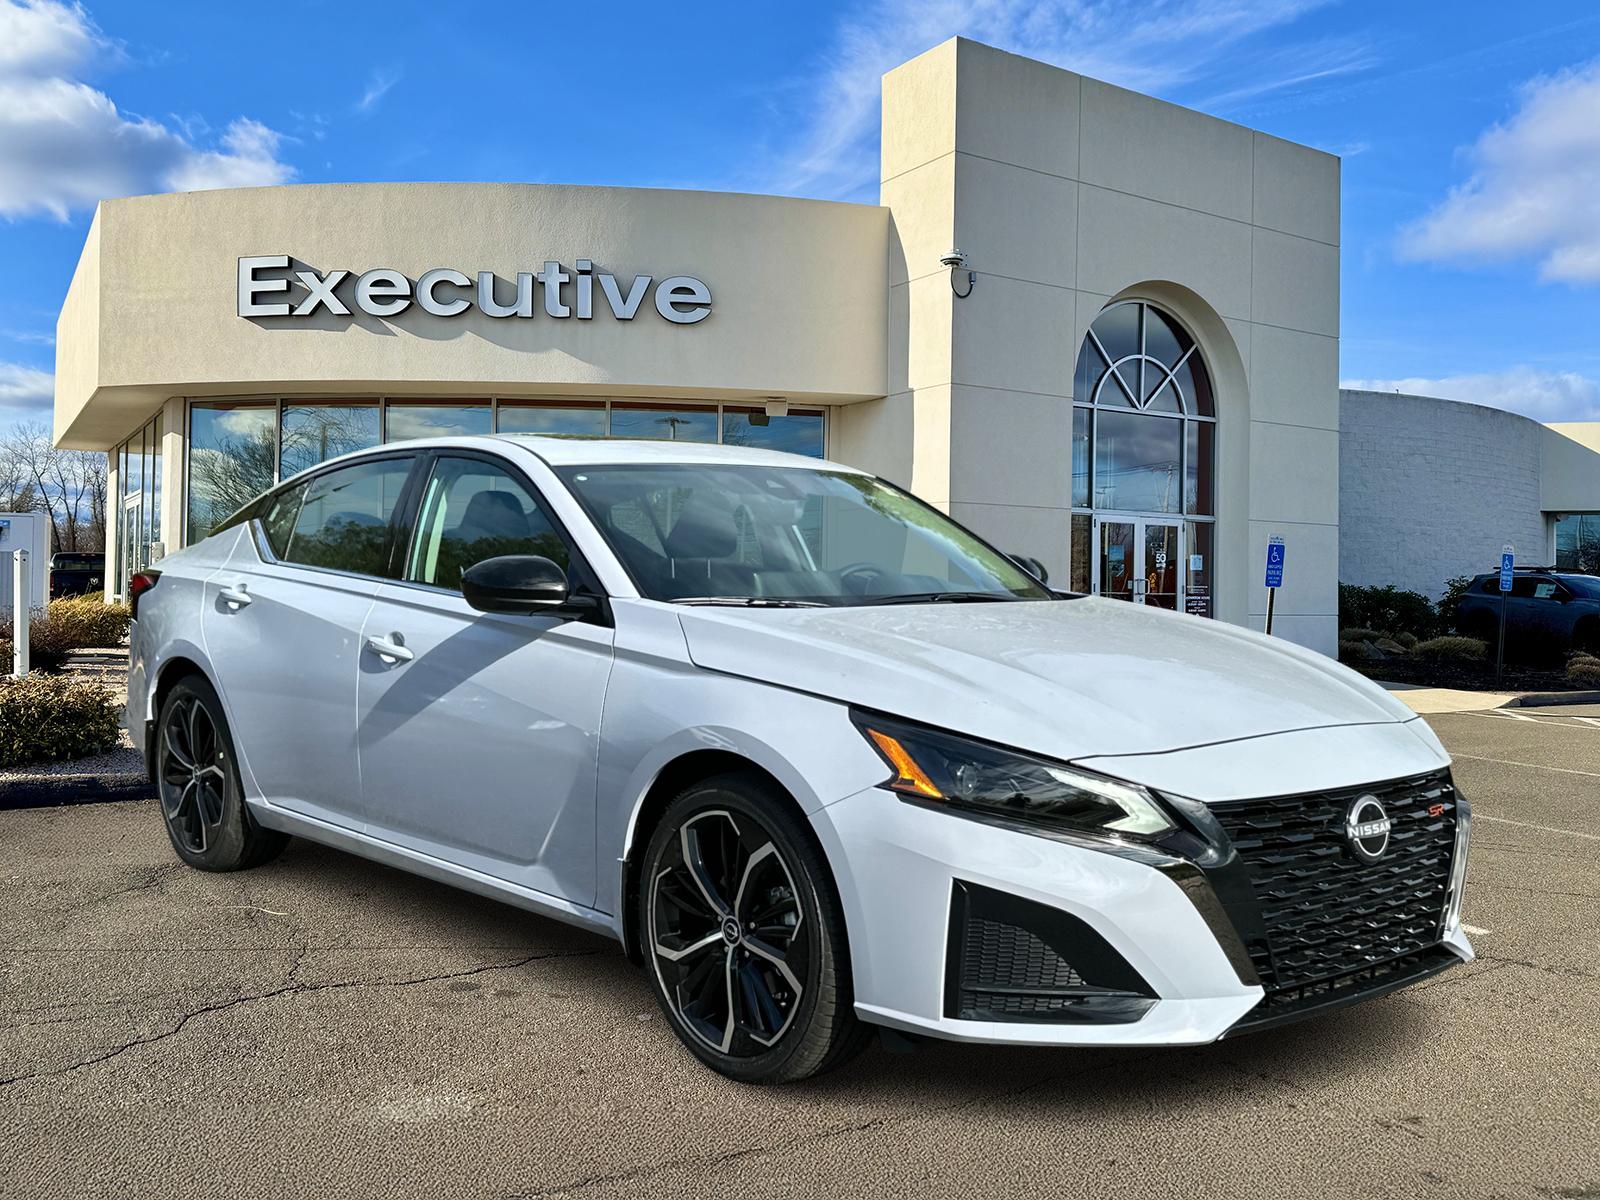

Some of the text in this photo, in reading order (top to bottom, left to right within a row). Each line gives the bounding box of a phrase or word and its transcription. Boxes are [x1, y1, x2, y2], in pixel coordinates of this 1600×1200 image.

[237, 254, 712, 324] Executive
[1156, 553, 1166, 563] 50
[1429, 804, 1444, 817] SR
[1348, 820, 1391, 838] NISSAN
